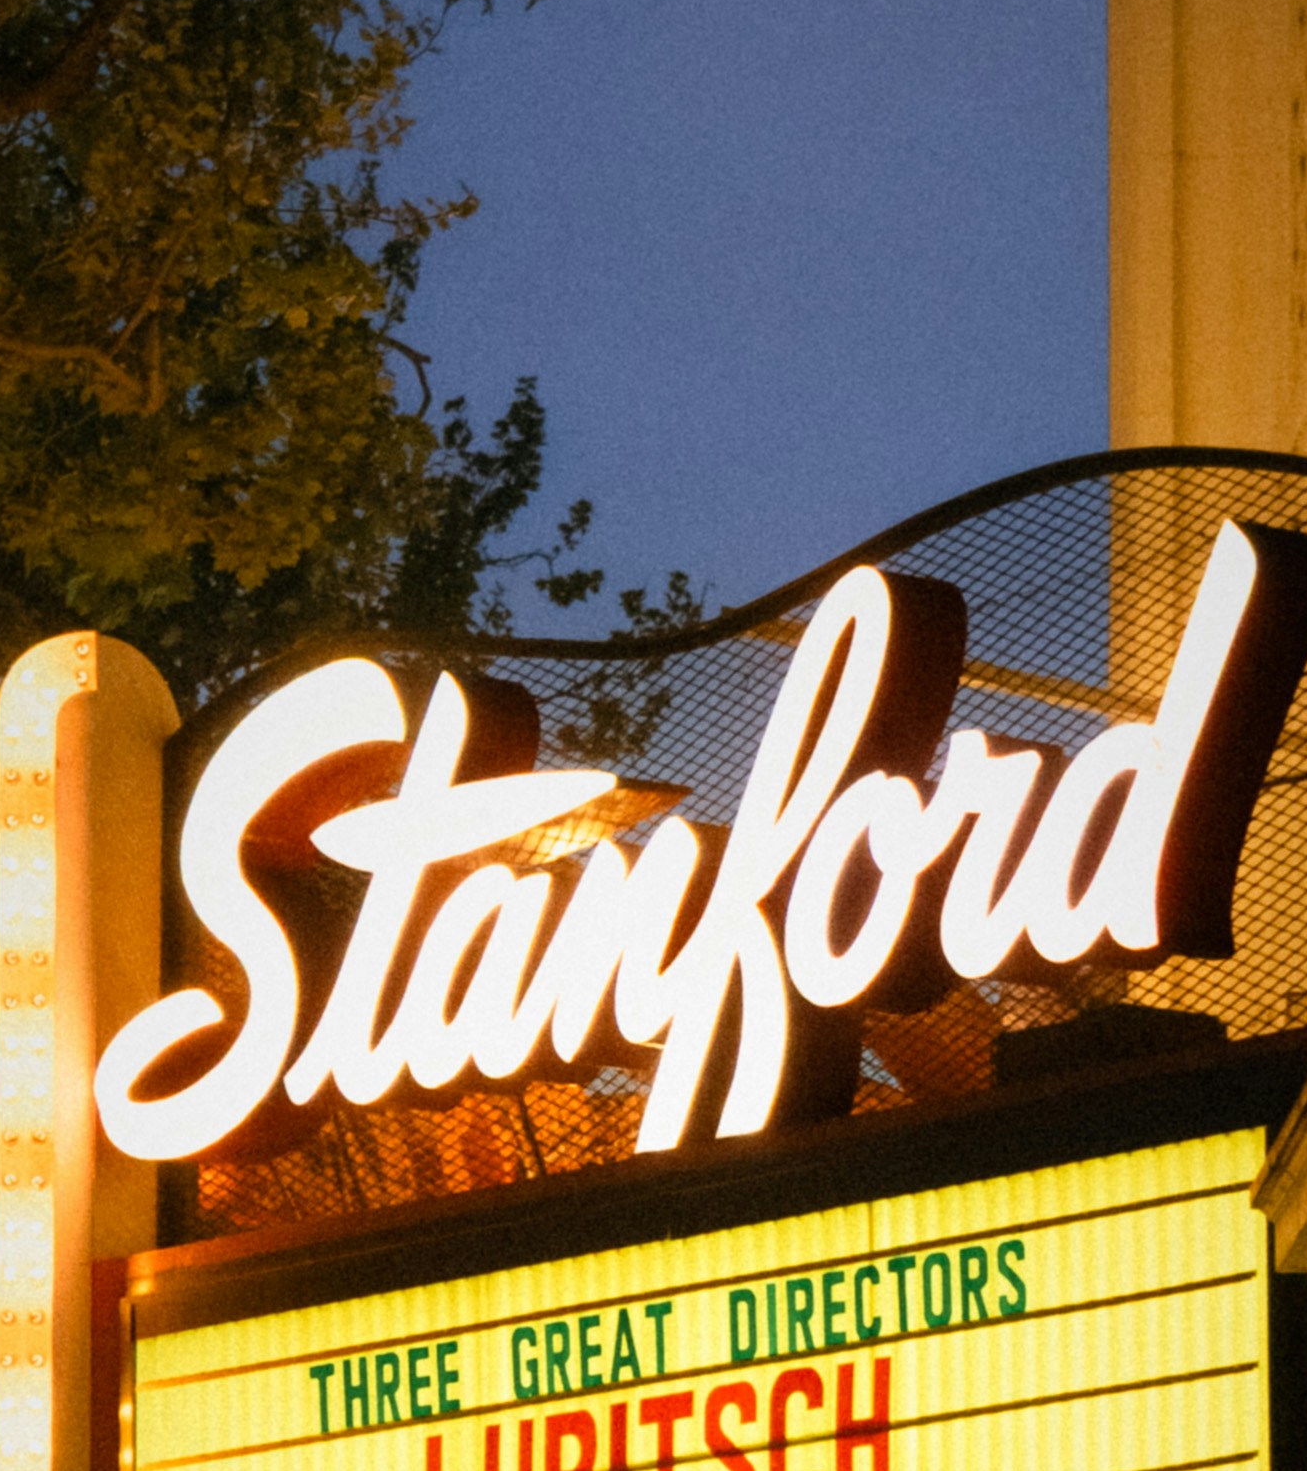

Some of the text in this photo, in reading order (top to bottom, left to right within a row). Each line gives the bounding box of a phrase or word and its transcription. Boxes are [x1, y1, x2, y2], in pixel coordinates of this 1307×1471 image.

[94, 519, 1258, 1160] Stanford
[310, 1239, 1027, 1434] THREE GREAT DIRECTORS
